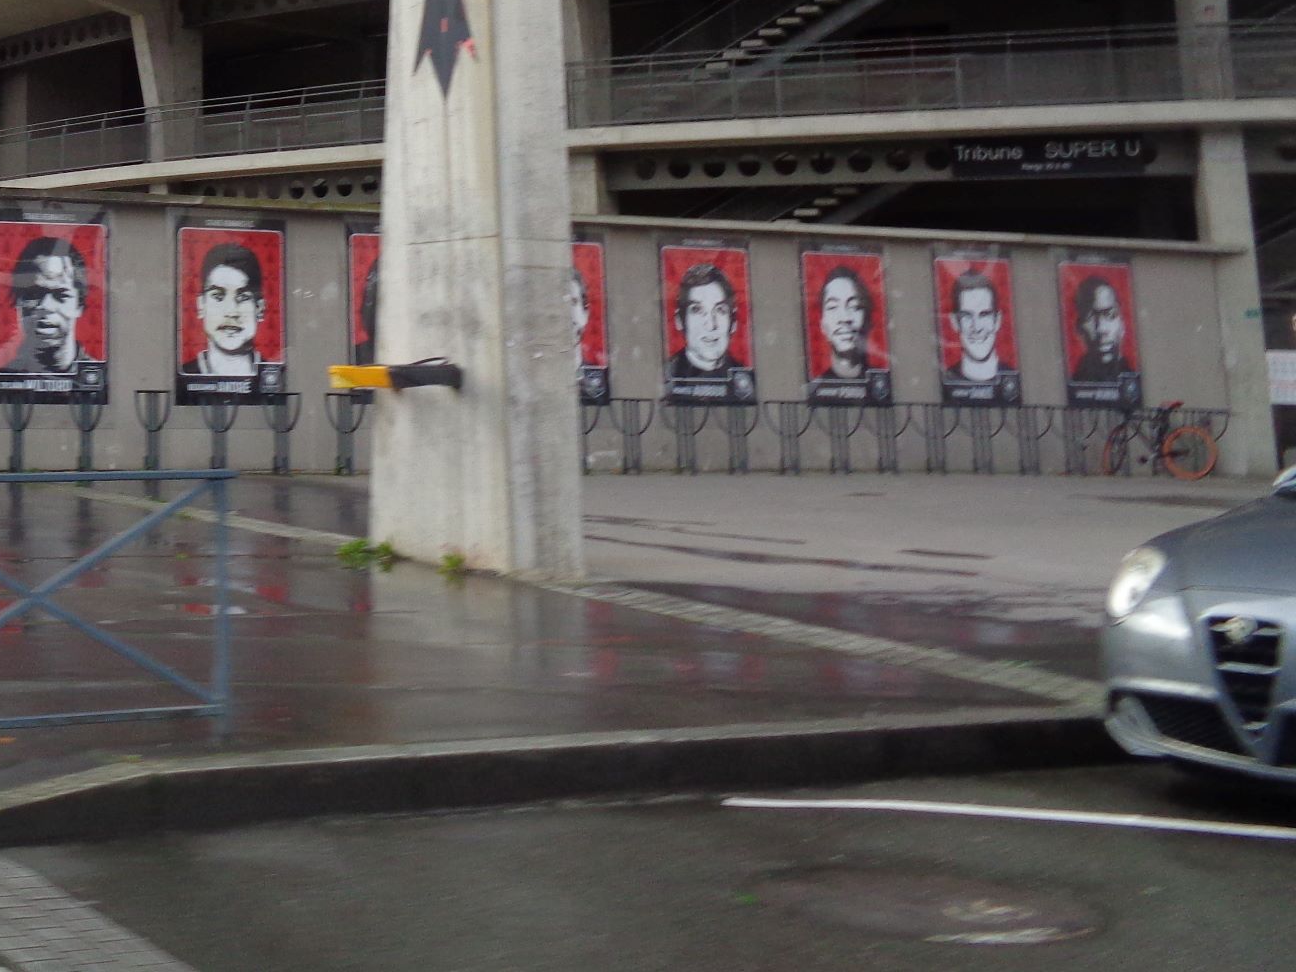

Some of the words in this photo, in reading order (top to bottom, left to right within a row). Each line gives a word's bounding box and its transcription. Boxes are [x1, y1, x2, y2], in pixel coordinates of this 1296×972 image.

[954, 144, 1024, 162] Tribune
[1044, 140, 1118, 159] SUPER
[1124, 139, 1141, 157] U
